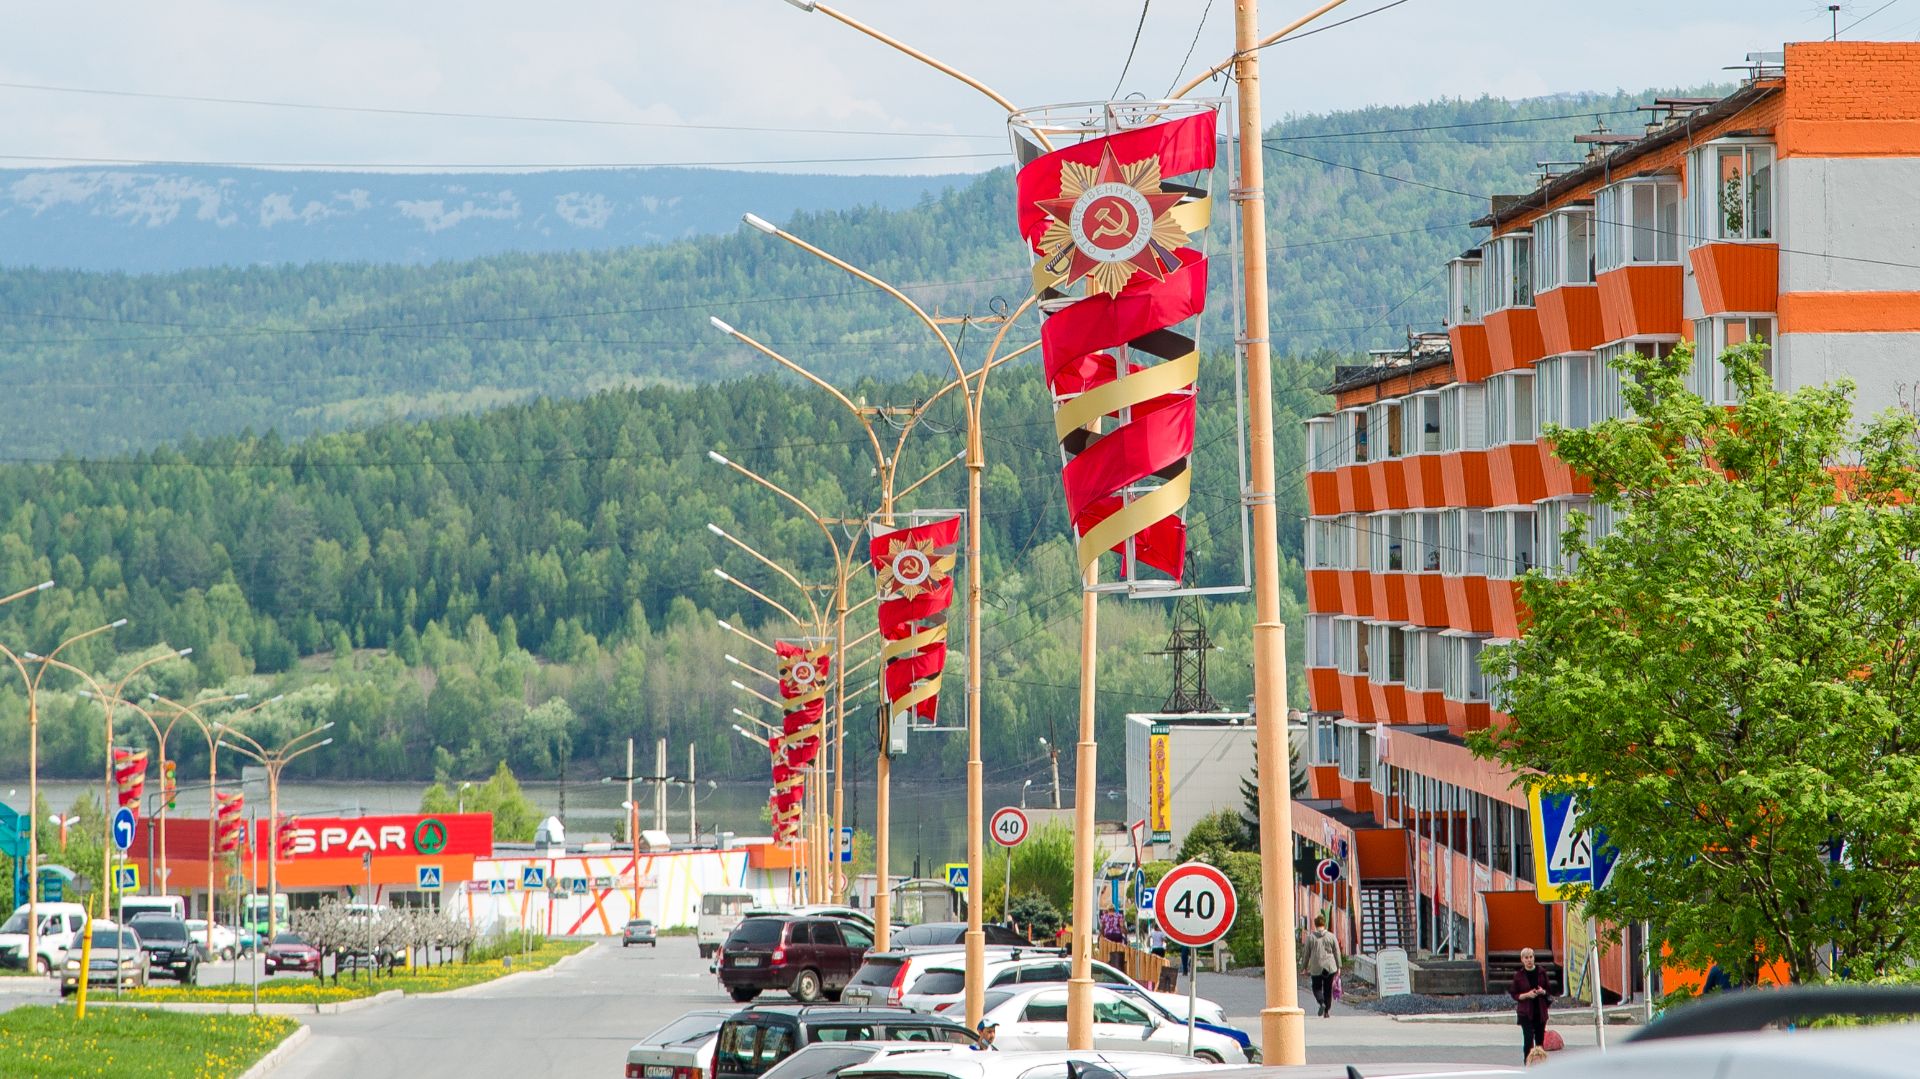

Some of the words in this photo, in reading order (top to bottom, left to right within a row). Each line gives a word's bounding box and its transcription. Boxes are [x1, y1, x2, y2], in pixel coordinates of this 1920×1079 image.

[1072, 185, 1141, 255] ОТЕЧЕСТВЕННАЯ
[294, 825, 407, 853] SPAR
[998, 819, 1020, 835] 40
[1142, 891, 1153, 906] P
[1174, 889, 1215, 920] 40
